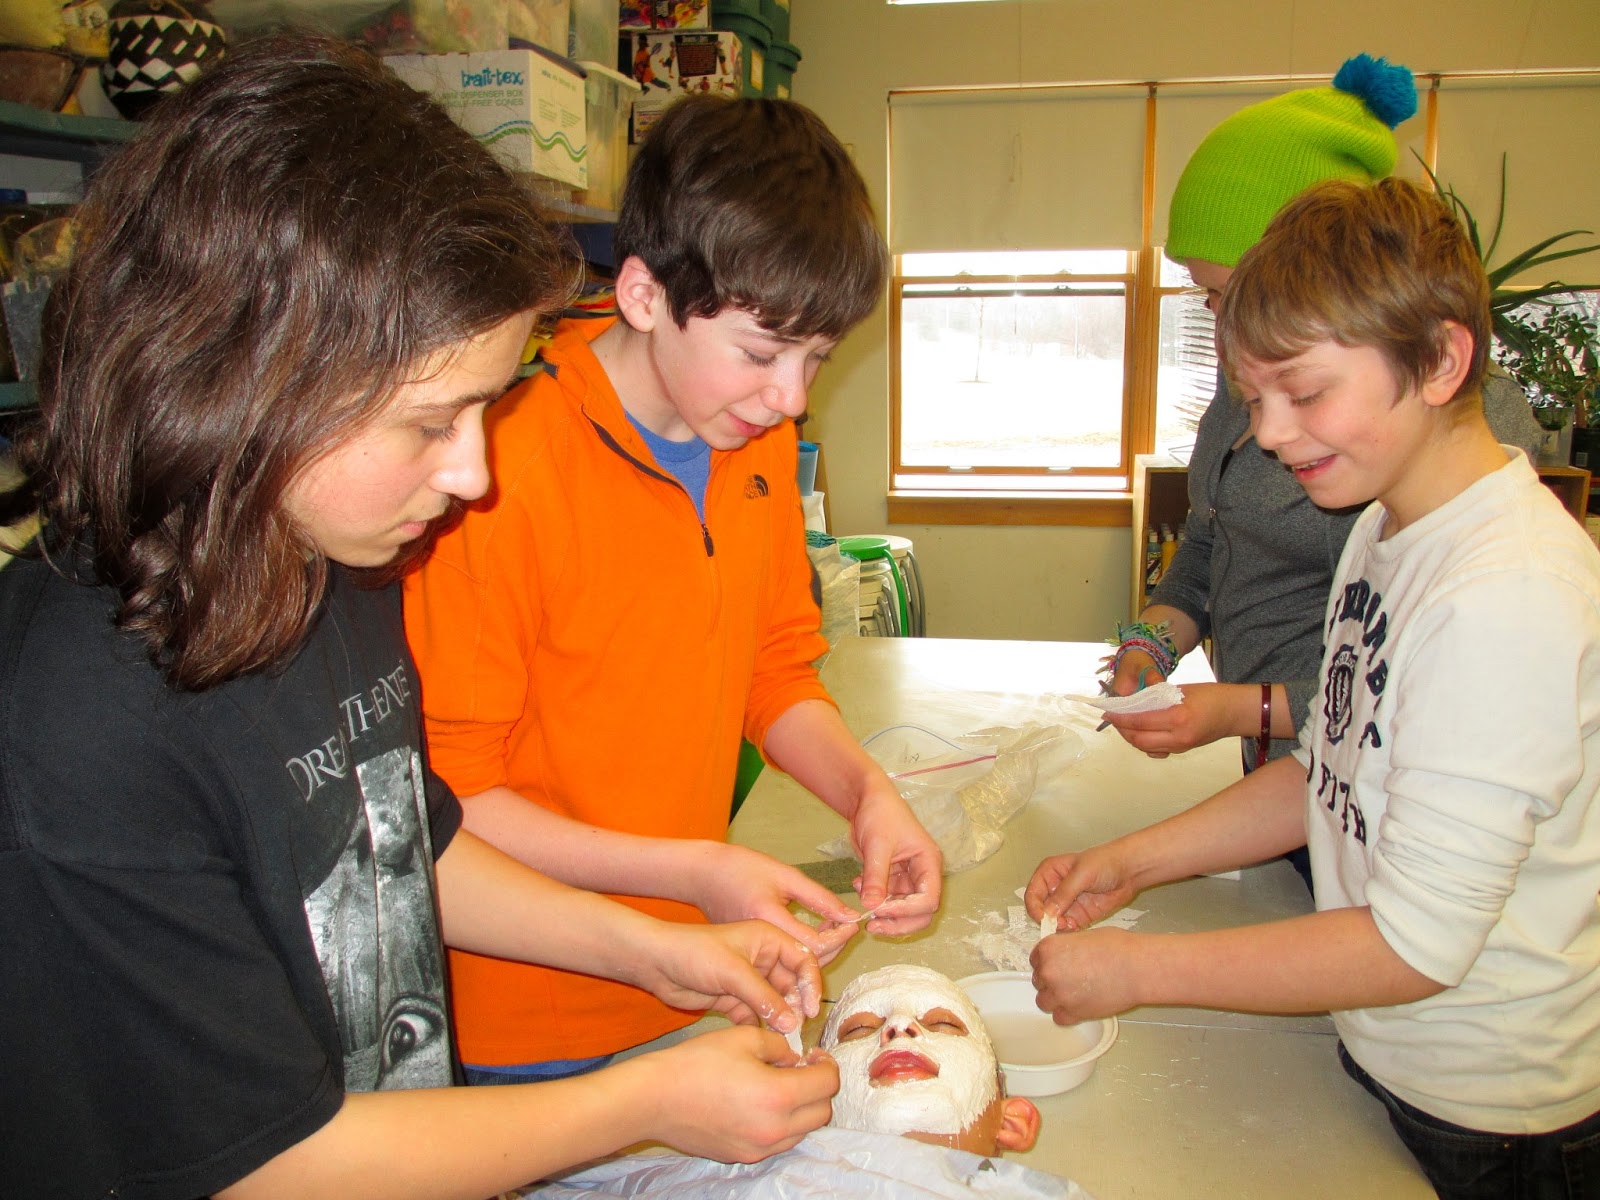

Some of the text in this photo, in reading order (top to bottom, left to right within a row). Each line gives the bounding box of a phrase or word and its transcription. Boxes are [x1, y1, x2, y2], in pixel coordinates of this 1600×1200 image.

[461, 67, 524, 88] trait-tex
[460, 89, 504, 99] DISPENSER
[507, 88, 524, 98] BOX
